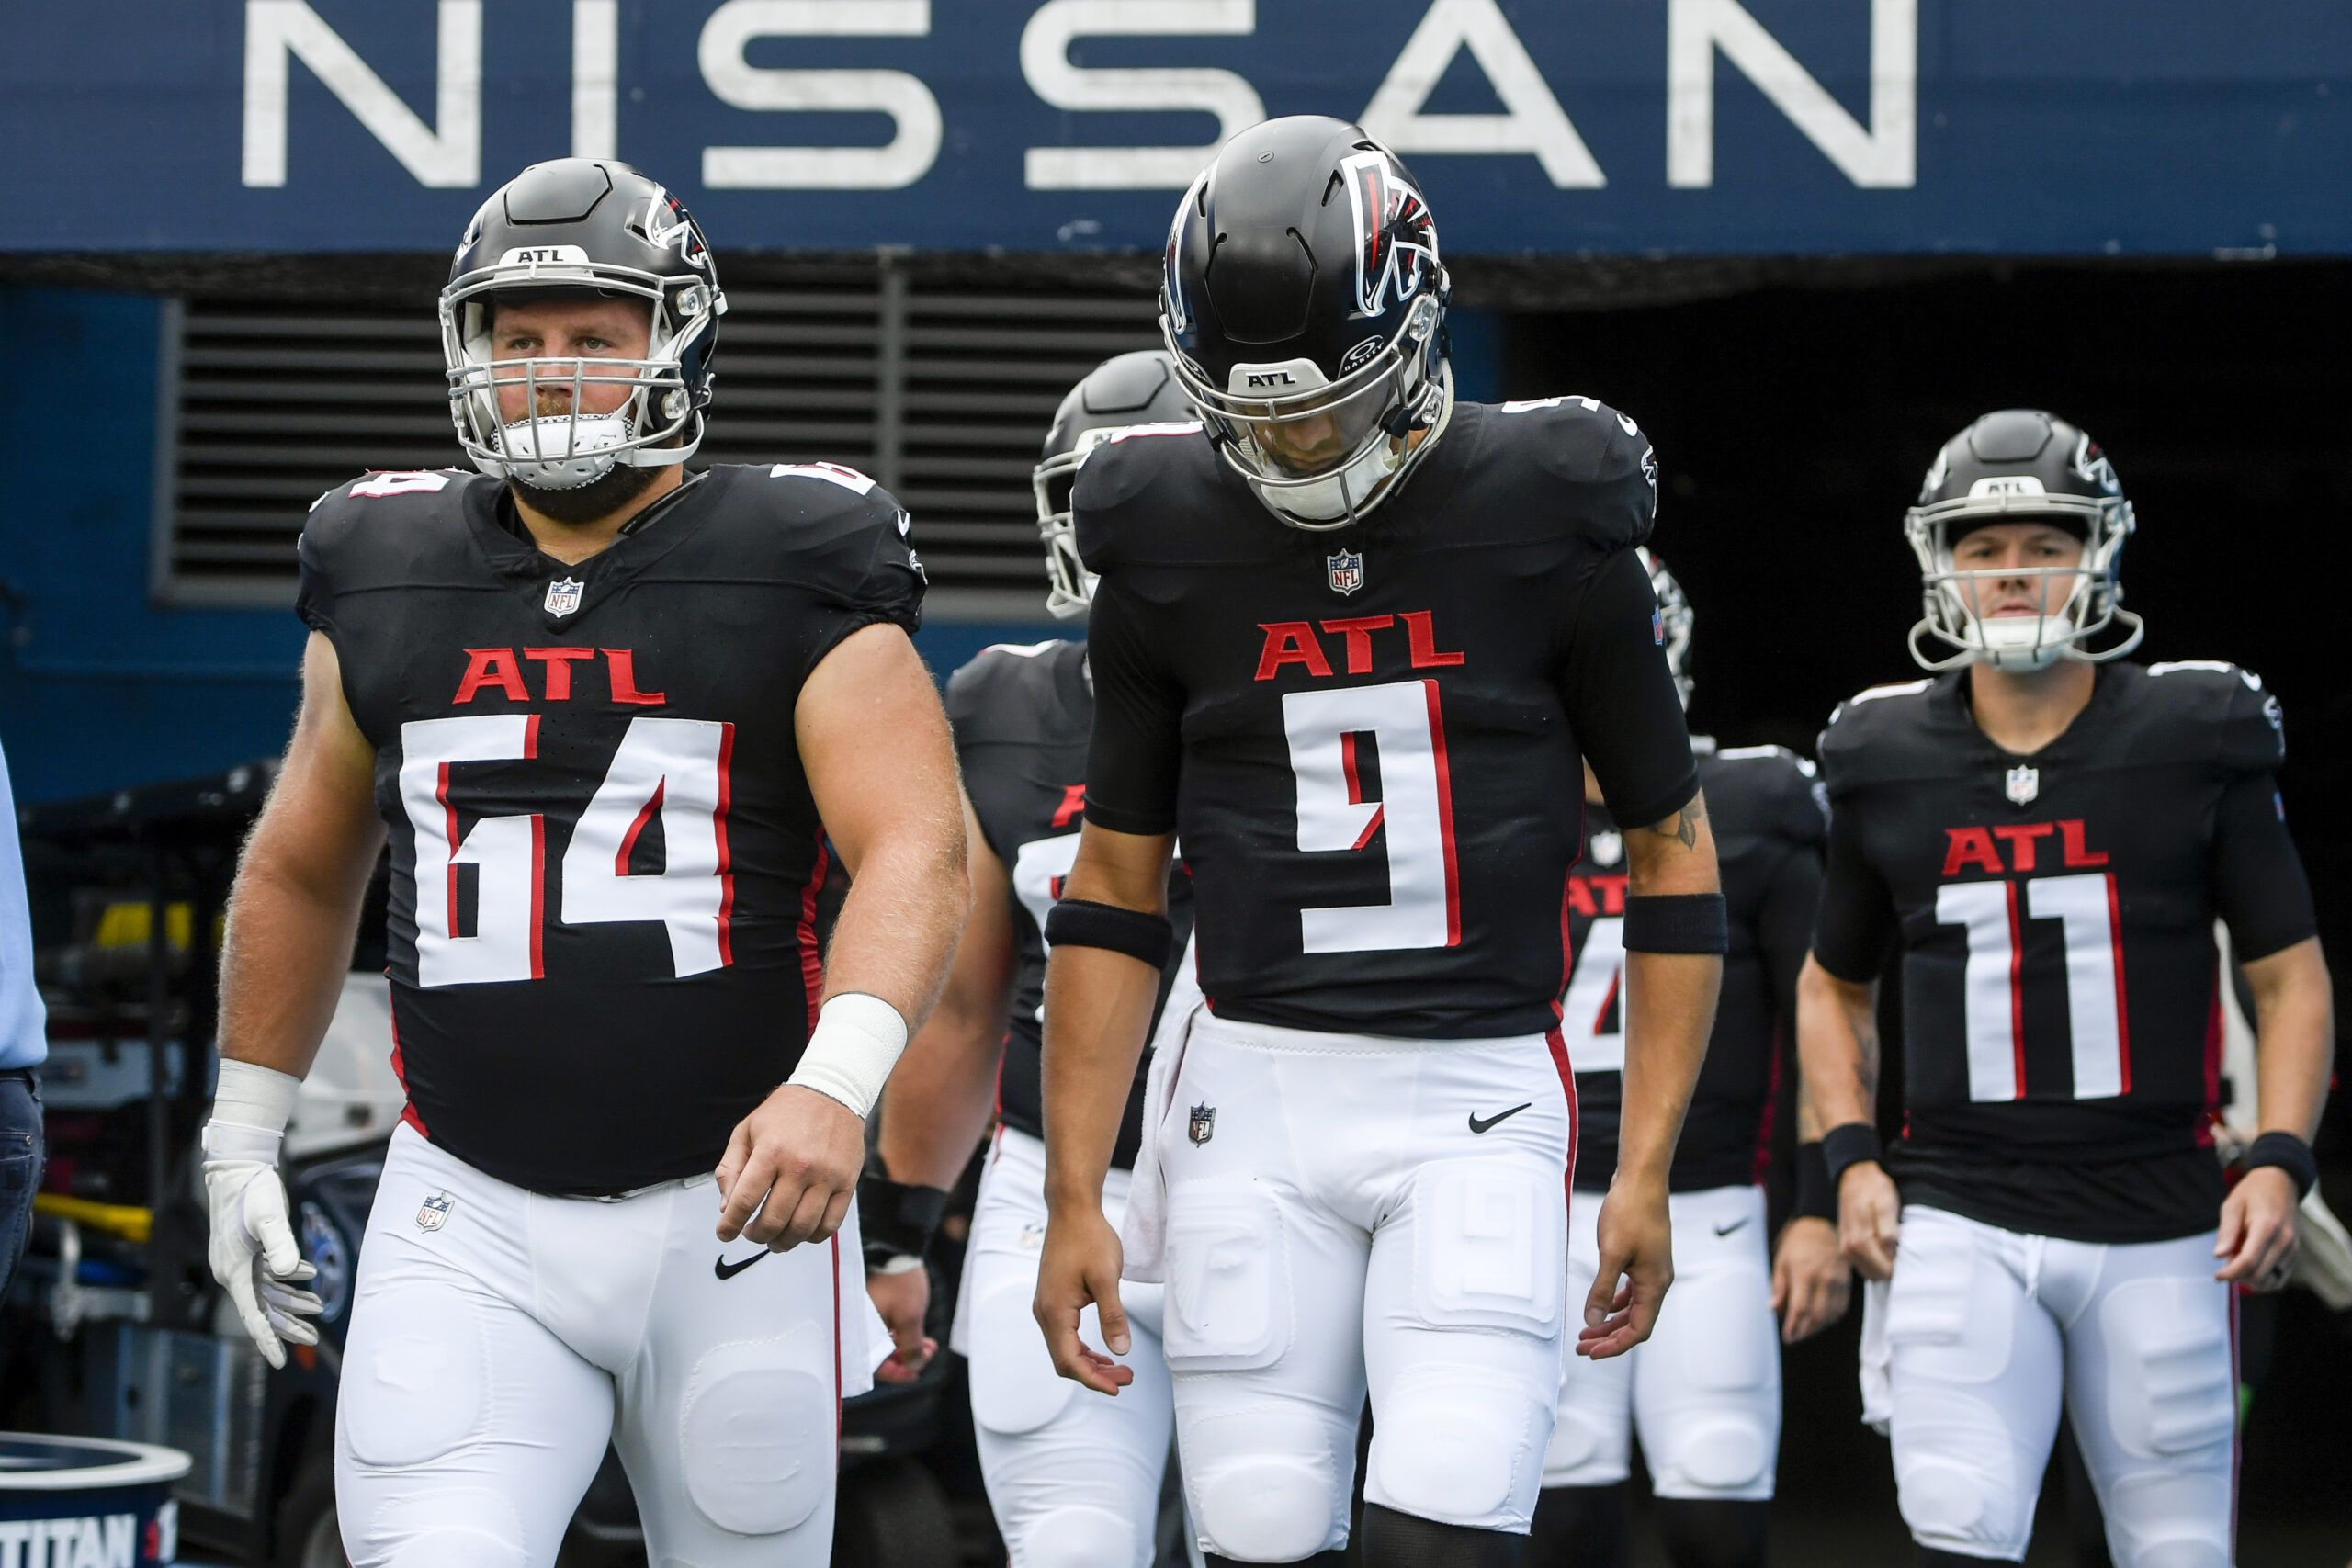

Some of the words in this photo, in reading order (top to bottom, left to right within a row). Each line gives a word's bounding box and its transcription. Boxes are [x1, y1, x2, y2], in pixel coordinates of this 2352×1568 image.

[242, 0, 1917, 190] NISSAN
[517, 249, 564, 263] ATL
[1247, 370, 1296, 388] ATL
[1344, 343, 1384, 372] OAKLEY
[550, 594, 573, 609] NFL
[1333, 570, 1358, 587] NFL
[1255, 610, 1465, 684] ATL
[452, 647, 666, 705] ATL
[1282, 678, 1462, 954] 9
[399, 714, 735, 987] 64
[1943, 818, 2109, 875] ATL
[1568, 875, 1629, 917] AT
[1936, 873, 2132, 1102] 11
[418, 1208, 440, 1225] NFL
